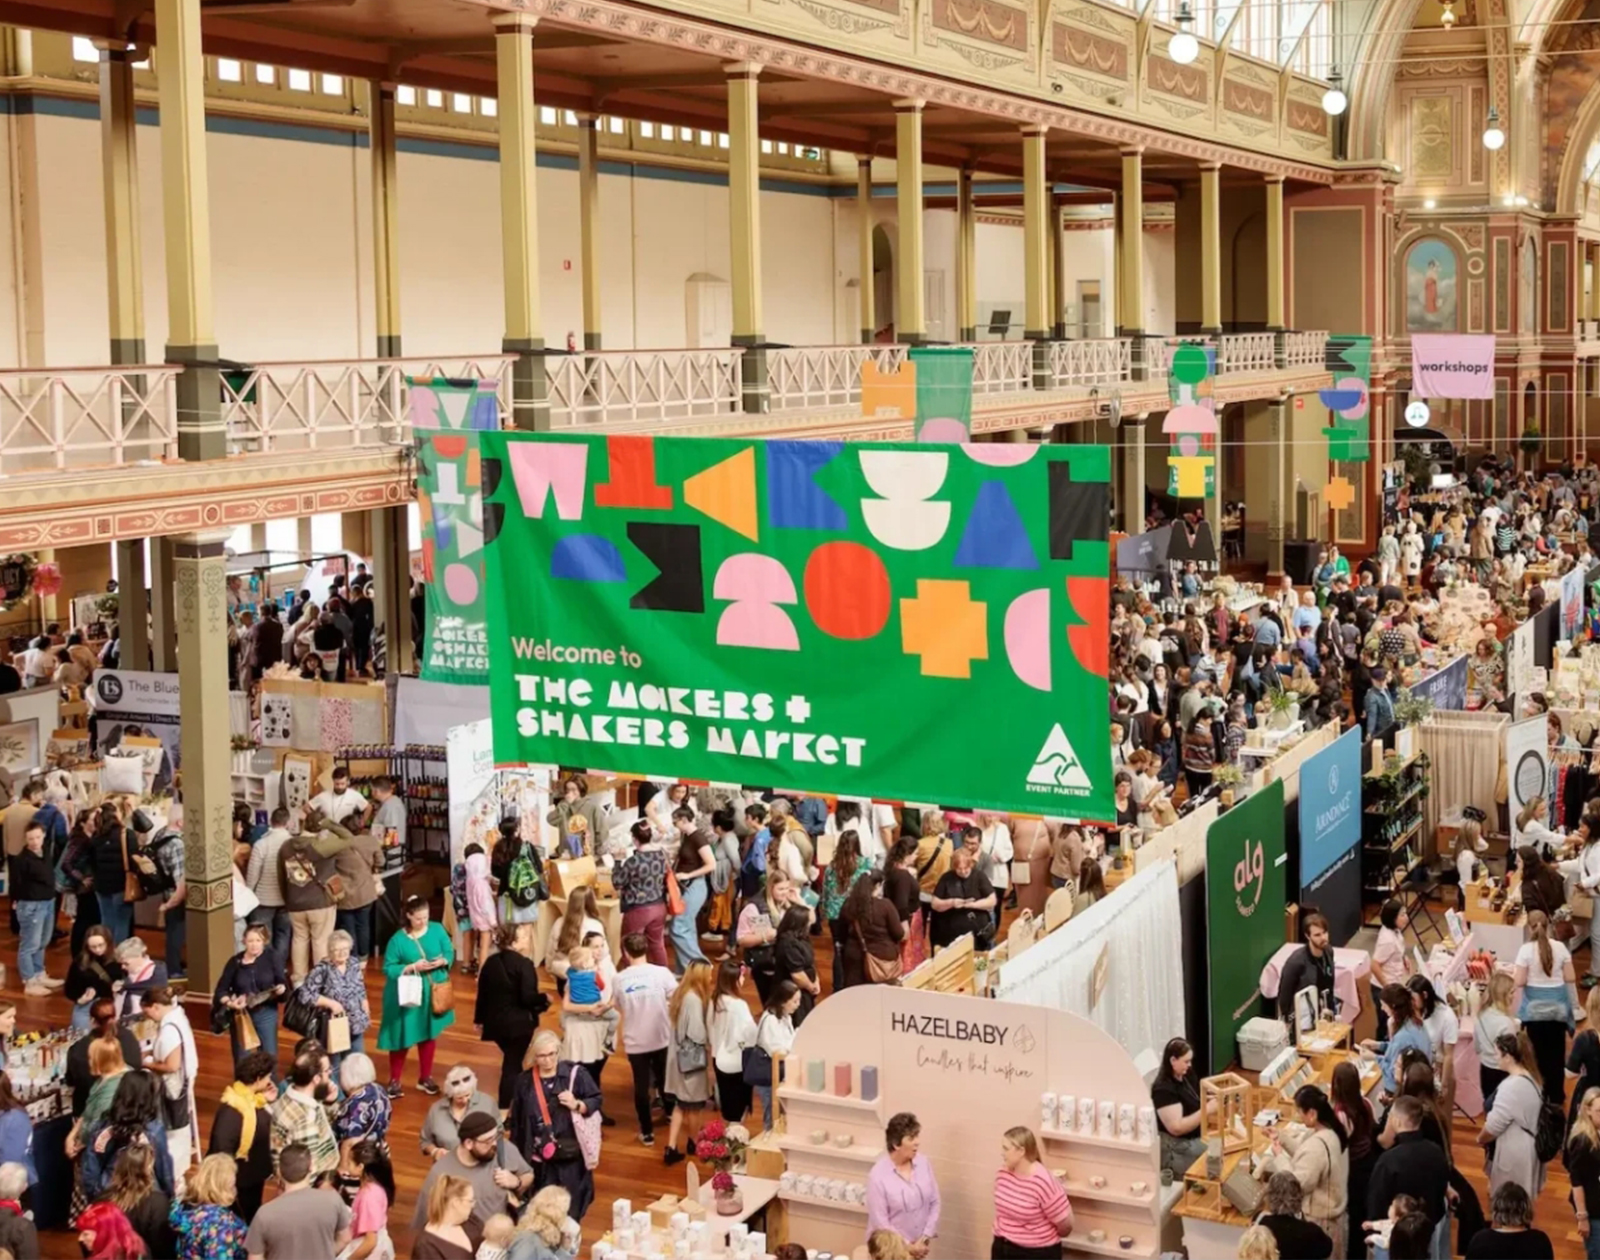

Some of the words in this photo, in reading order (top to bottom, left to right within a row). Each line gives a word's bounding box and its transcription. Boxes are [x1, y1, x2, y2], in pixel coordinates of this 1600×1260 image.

[1420, 361, 1488, 375] workshops
[511, 637, 615, 666] Welcome
[620, 646, 642, 668] to
[129, 680, 150, 692] The
[154, 681, 180, 694] Blue
[514, 674, 593, 707] THE
[516, 707, 690, 749] SHAKERS
[1026, 784, 1052, 793] EVENT
[1054, 787, 1090, 797] PARTNER
[1234, 839, 1264, 905] alg
[892, 1012, 1009, 1046] HAZELBABY
[917, 1045, 963, 1073] Candles
[969, 1051, 989, 1076] that
[994, 1061, 1034, 1084] inspire
